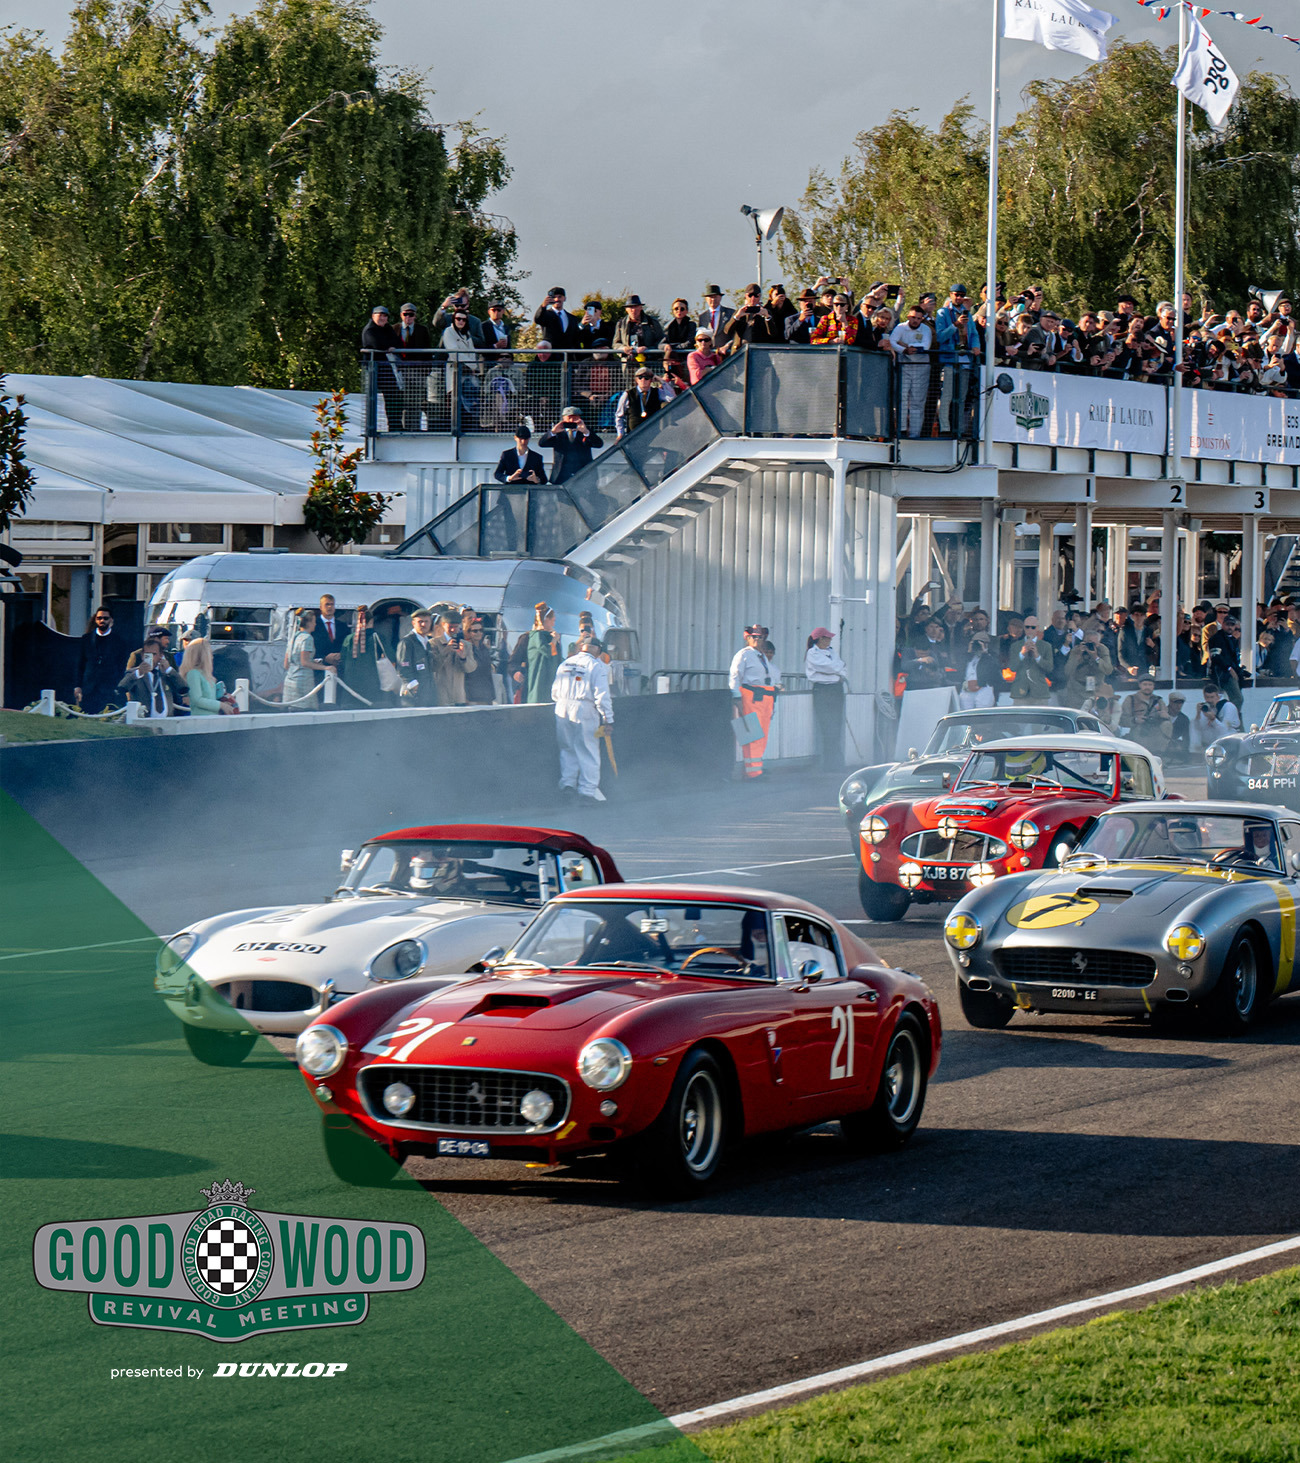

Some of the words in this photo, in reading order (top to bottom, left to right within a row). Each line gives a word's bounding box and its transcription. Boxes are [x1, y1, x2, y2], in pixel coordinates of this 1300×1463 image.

[1088, 404, 1116, 422] RALPH
[1120, 407, 1154, 427] LAUREN
[1190, 436, 1231, 450] EDMISTON
[1086, 478, 1091, 497] 1
[1170, 485, 1182, 503] 2
[1254, 491, 1265, 508] 3
[1248, 778, 1269, 790] 844
[1273, 777, 1297, 789] PPH
[923, 865, 947, 880] XJB
[1020, 895, 1092, 922] 7
[235, 943, 268, 952] AH
[274, 943, 320, 954] 600
[1052, 988, 1076, 998] 02010
[1085, 990, 1097, 1000] EE
[360, 1017, 456, 1062] 21
[829, 1005, 854, 1080] 21
